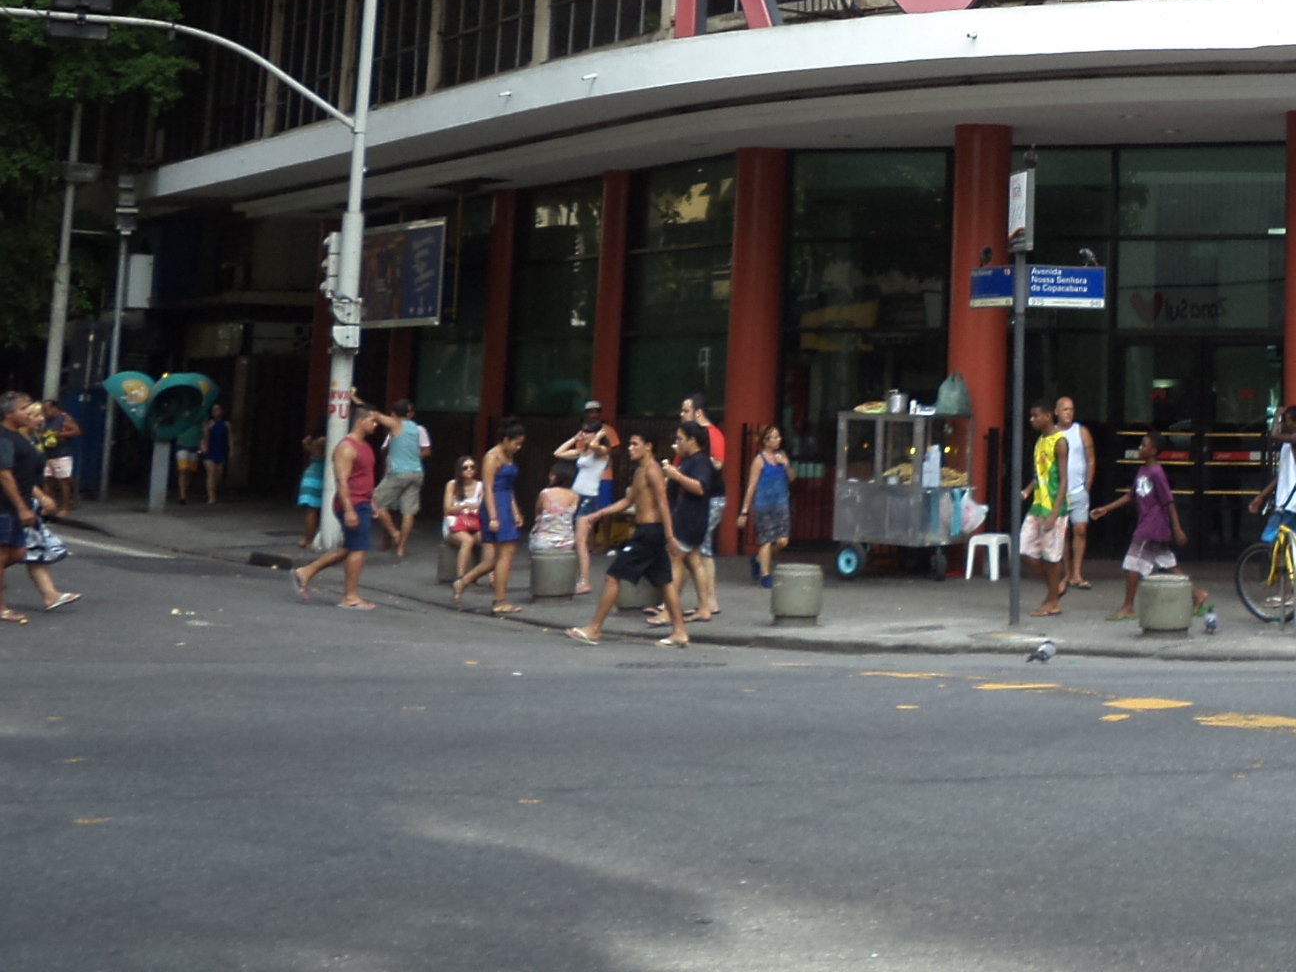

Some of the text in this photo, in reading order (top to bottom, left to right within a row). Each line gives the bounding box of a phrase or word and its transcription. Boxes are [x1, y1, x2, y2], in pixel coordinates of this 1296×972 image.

[1031, 267, 1062, 275] Avenida
[1031, 276, 1088, 284] Nossa Senhora
[1042, 284, 1088, 293] Copacabana
